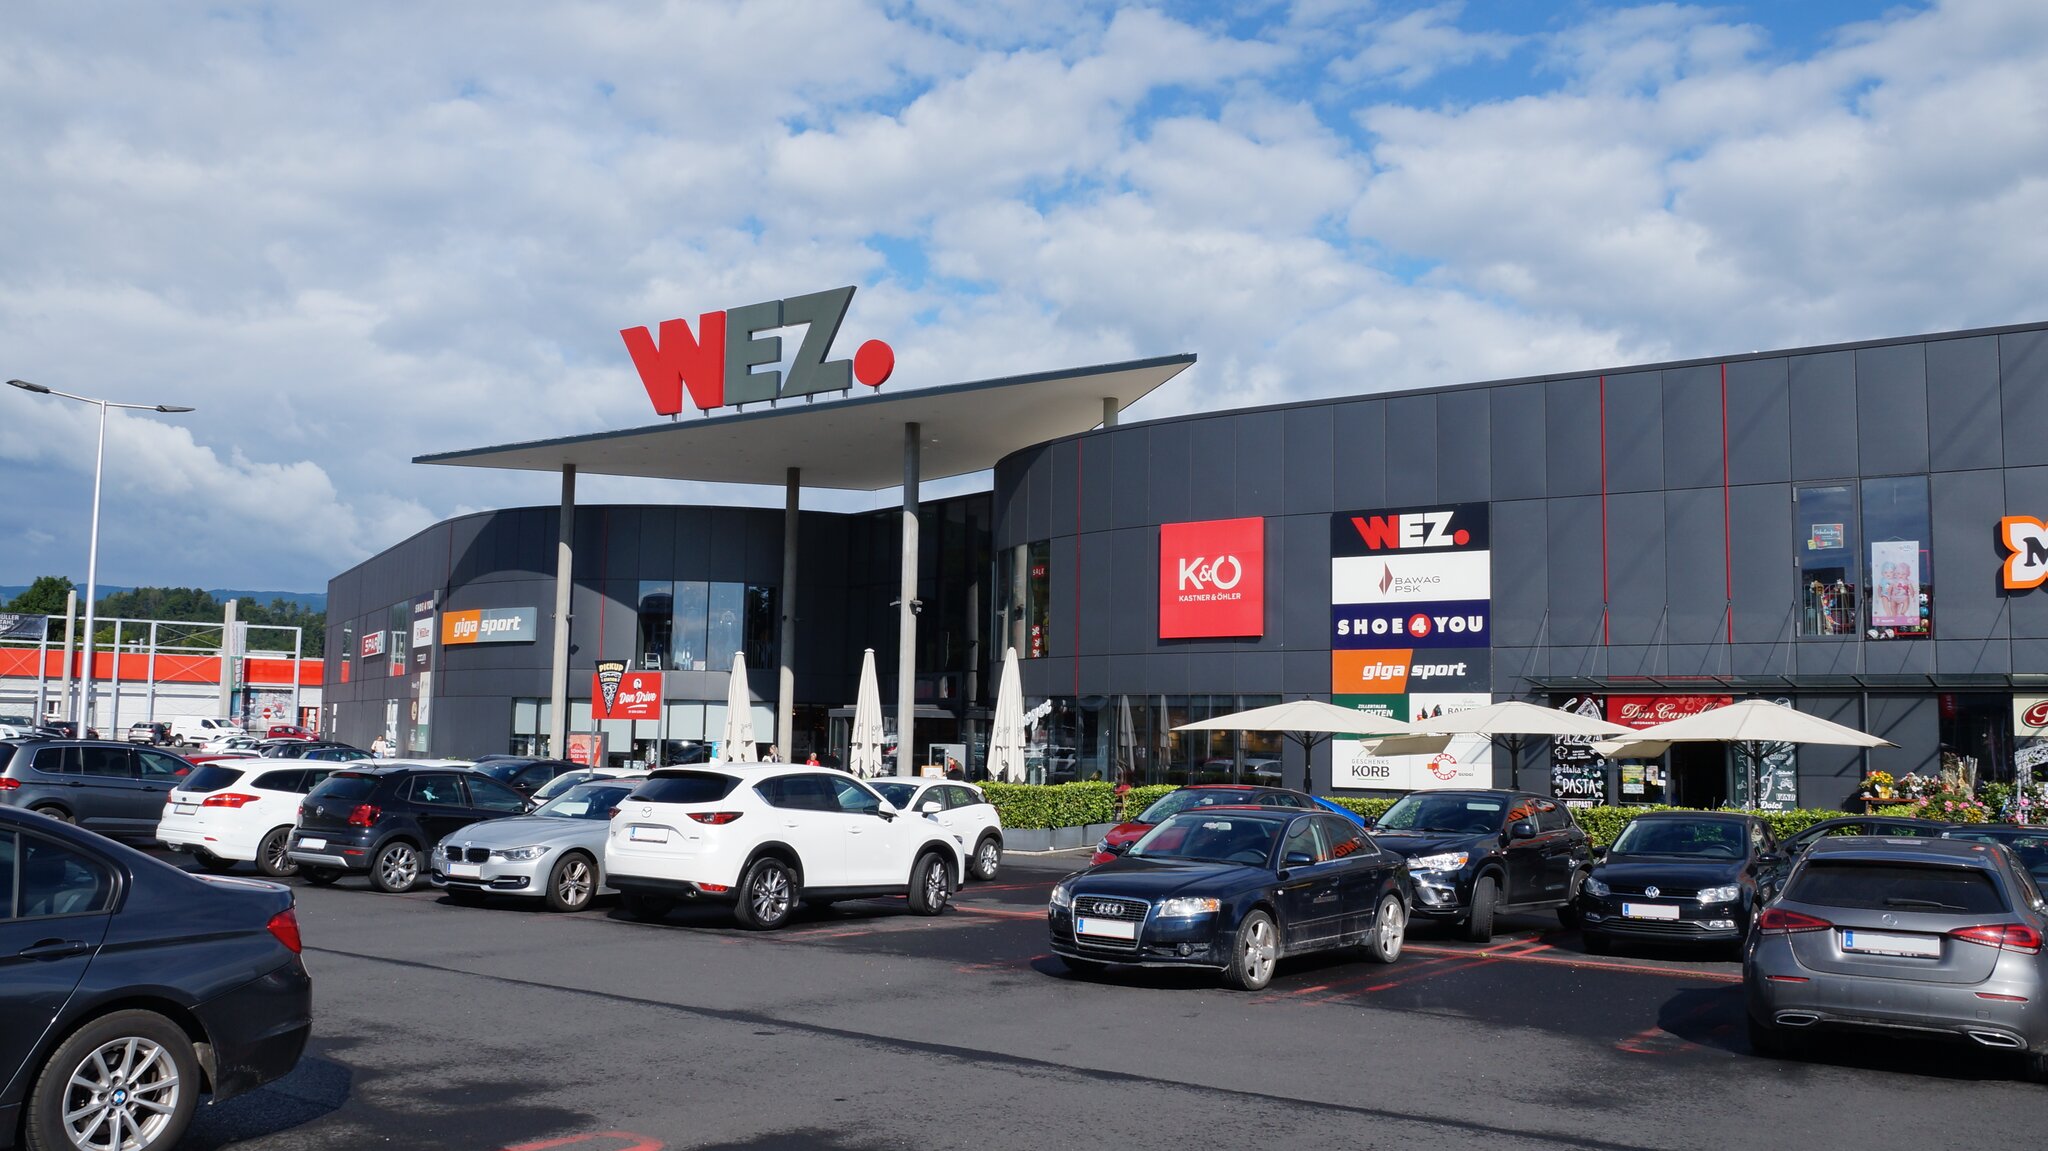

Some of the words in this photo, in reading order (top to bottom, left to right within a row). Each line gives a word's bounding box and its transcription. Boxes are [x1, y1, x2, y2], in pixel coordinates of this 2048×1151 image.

[1395, 575, 1441, 585] BAWAG
[1395, 585, 1421, 593] PSK
[1179, 594, 1211, 602] KASTNER
[1217, 591, 1242, 600] ÖHLER
[453, 617, 478, 638] giga
[480, 615, 522, 636] sport
[1337, 618, 1404, 636] SHOE
[1411, 617, 1427, 634] 4
[1433, 615, 1483, 633] YOU
[599, 662, 624, 672] PICKUP
[1362, 662, 1406, 680] giga
[1411, 662, 1467, 680] sport
[619, 692, 635, 704] Don
[635, 691, 657, 703] Drive
[1620, 703, 1655, 719] Don
[1352, 765, 1390, 777] KORB
[1562, 779, 1596, 794] PASTA
[1760, 801, 1783, 810] Dolci
